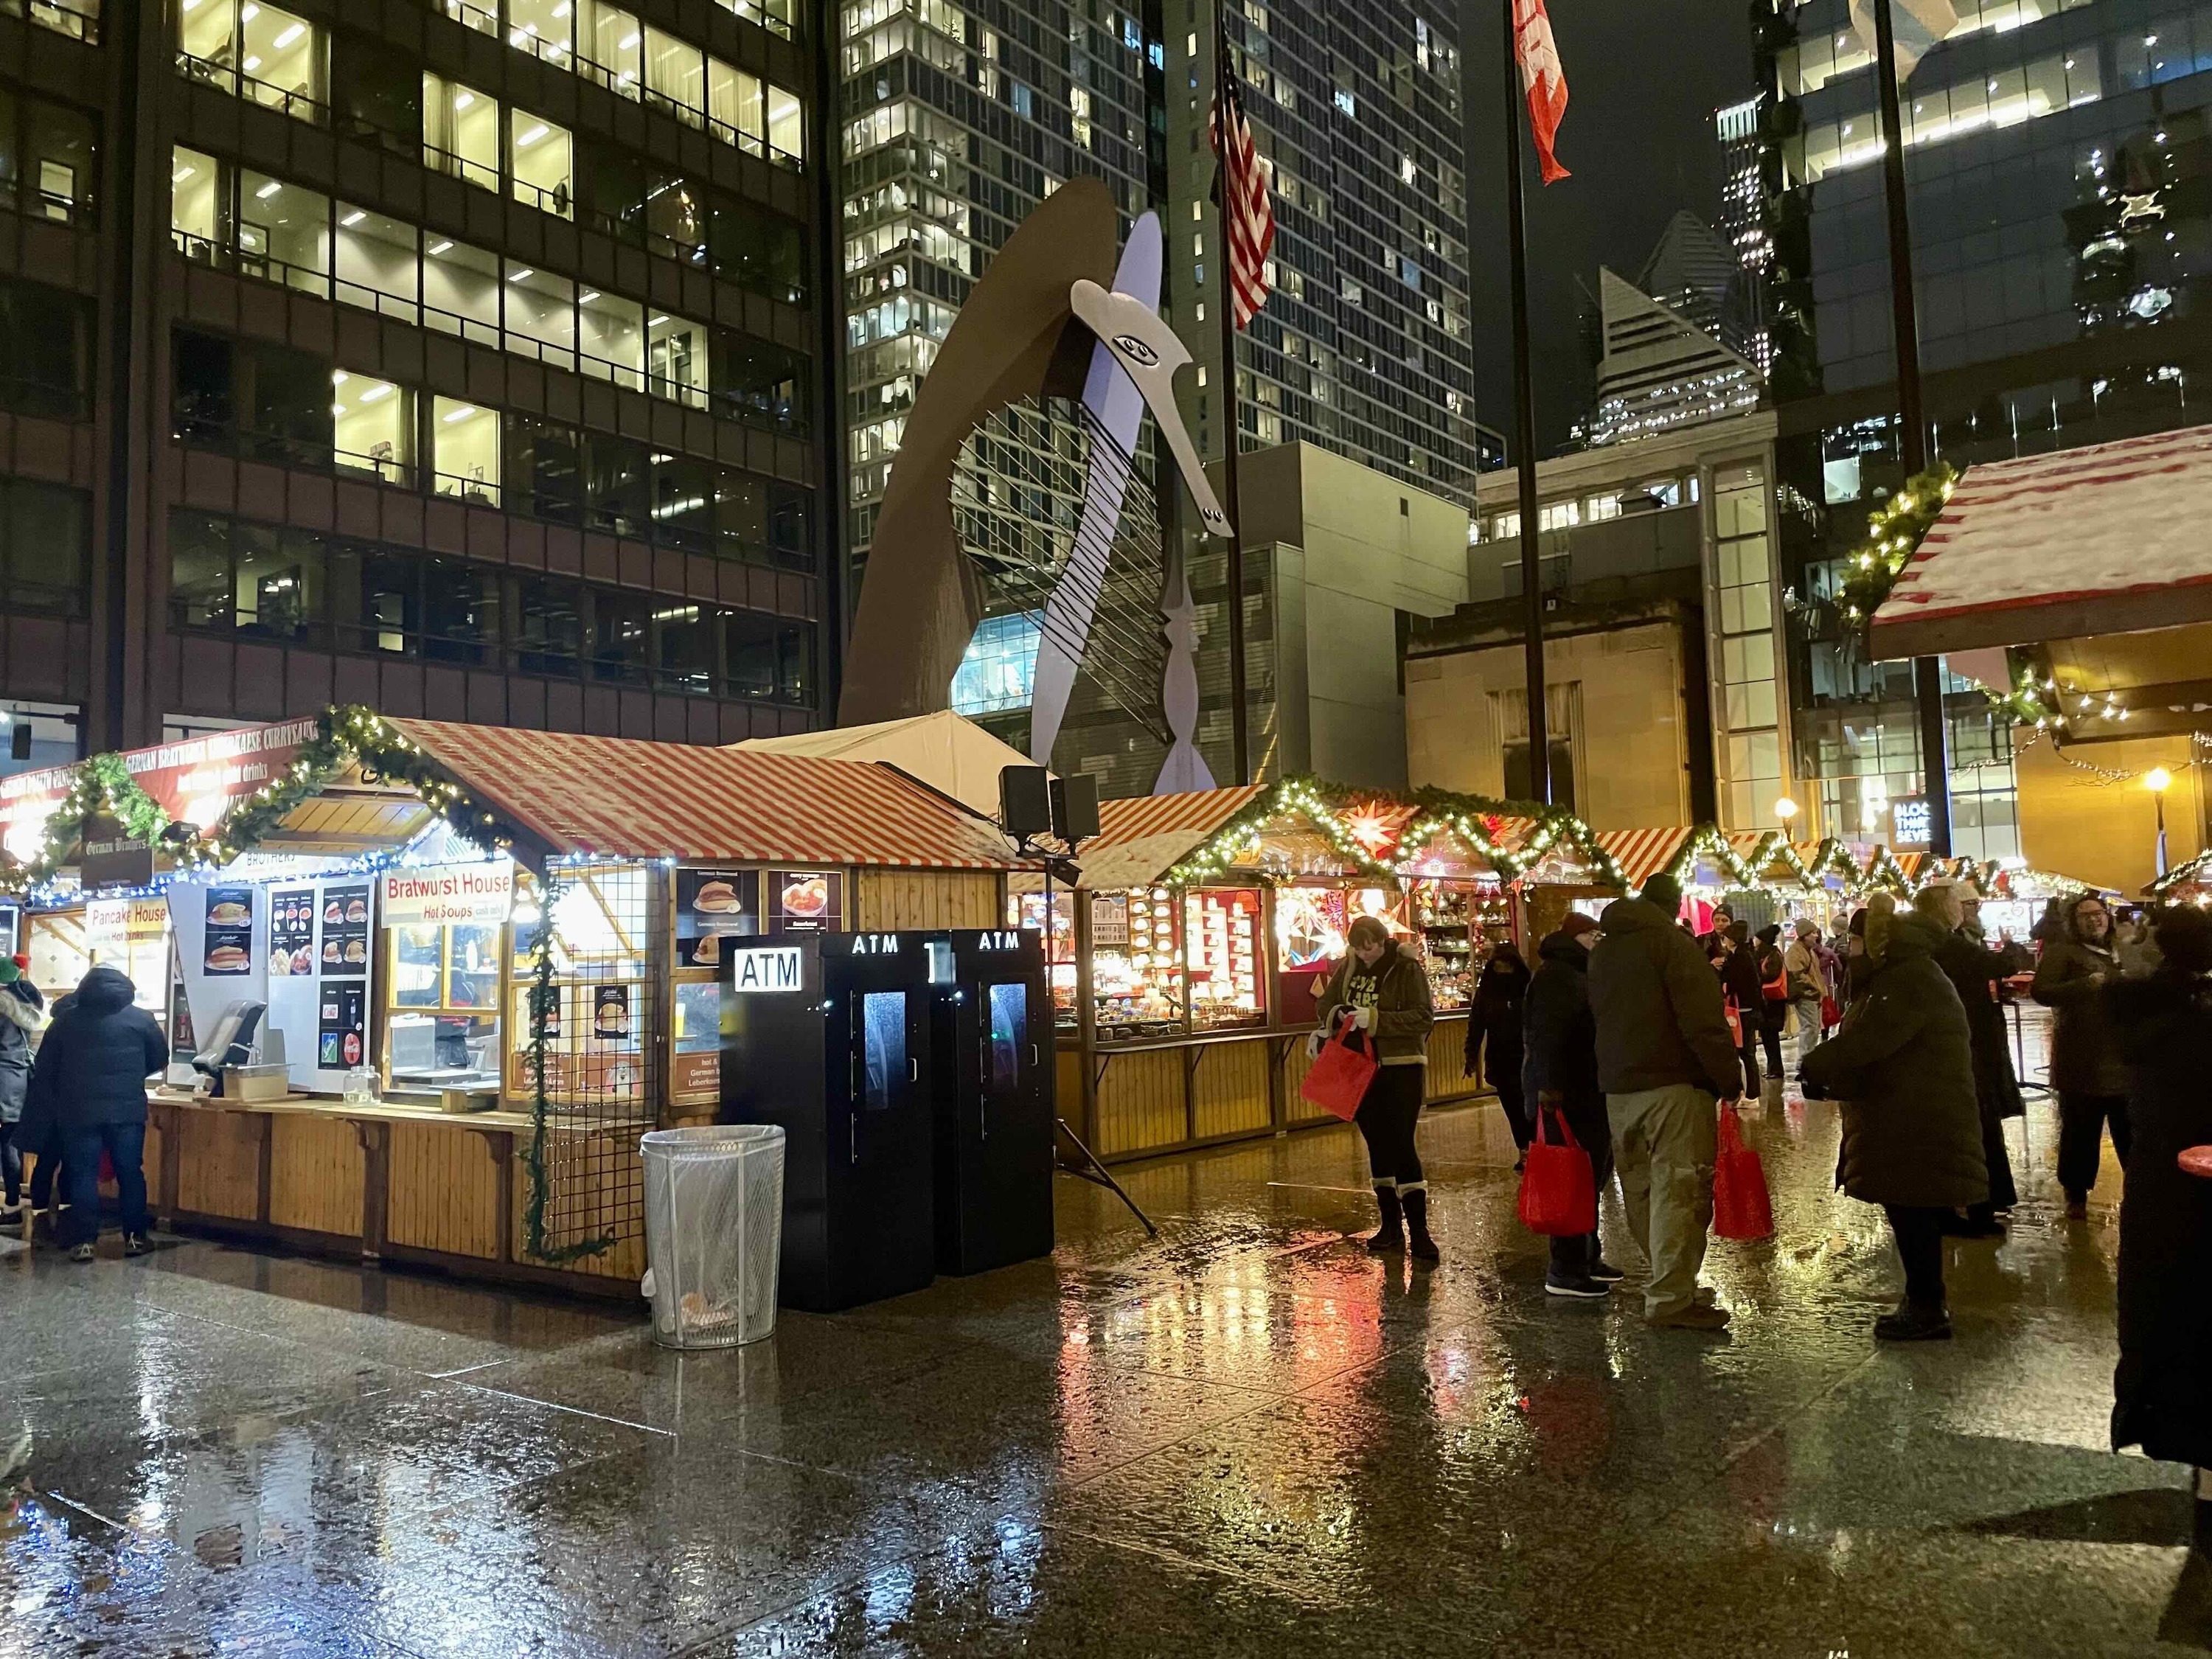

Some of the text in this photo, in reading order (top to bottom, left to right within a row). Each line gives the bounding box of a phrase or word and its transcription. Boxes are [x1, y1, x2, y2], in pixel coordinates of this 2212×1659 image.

[243, 762, 268, 782] drinks
[388, 873, 509, 899] Bratwurst House
[93, 905, 166, 926] Pancake House
[424, 904, 472, 919] Hot Soups
[852, 934, 898, 954] ATM
[978, 931, 1019, 950] ATM
[740, 953, 798, 987] ATM
[690, 1068, 714, 1077] German
